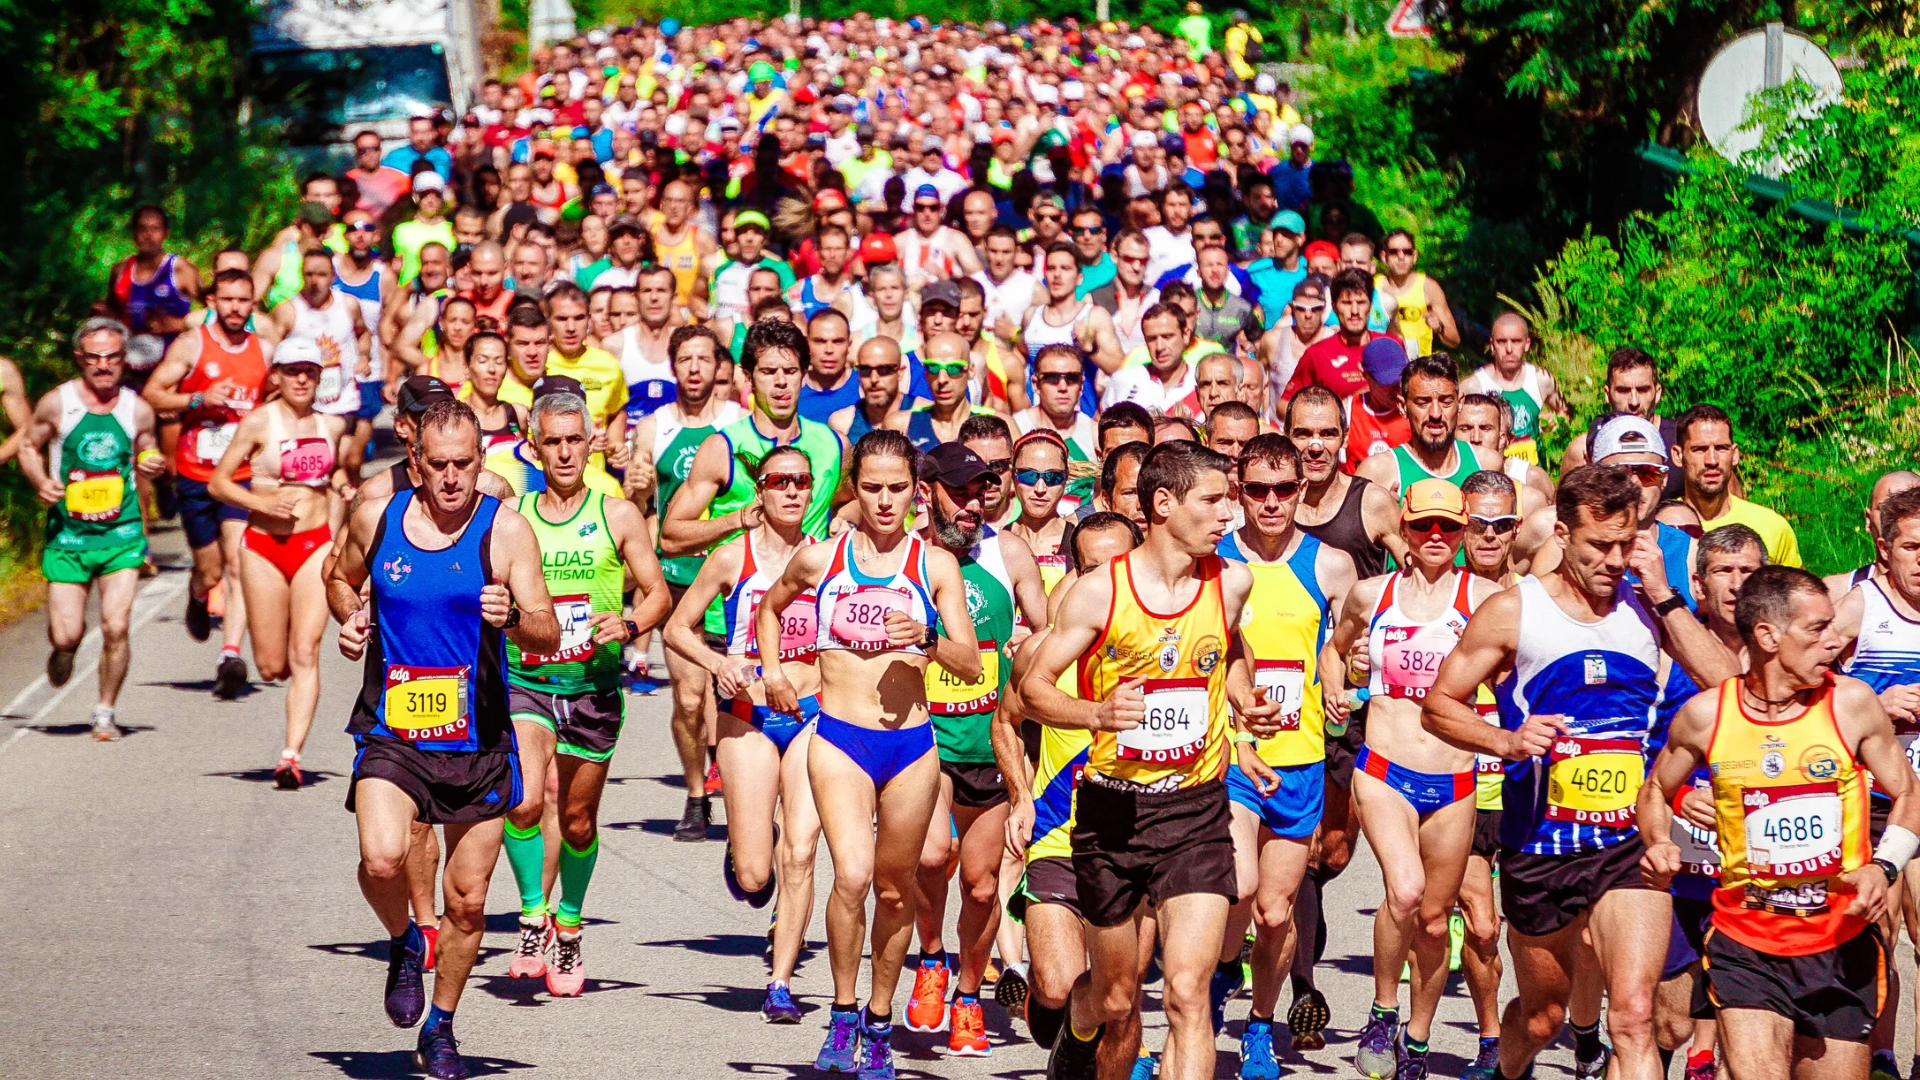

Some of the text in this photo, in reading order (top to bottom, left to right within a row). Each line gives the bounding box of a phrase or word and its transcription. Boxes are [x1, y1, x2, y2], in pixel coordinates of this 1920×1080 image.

[292, 456, 324, 471] 4685
[542, 550, 594, 567] LDAS
[543, 569, 595, 581] ETISMO
[779, 643, 816, 660] OURO
[389, 667, 410, 685] edp
[407, 692, 447, 713] 3119
[947, 690, 997, 712] DOURO
[408, 718, 466, 739] DOURO
[1142, 738, 1205, 762] DOURO
[1555, 740, 1582, 758] edp
[1571, 768, 1626, 794] 4620
[1764, 815, 1824, 843] 4686
[1774, 846, 1842, 876] DOURO
